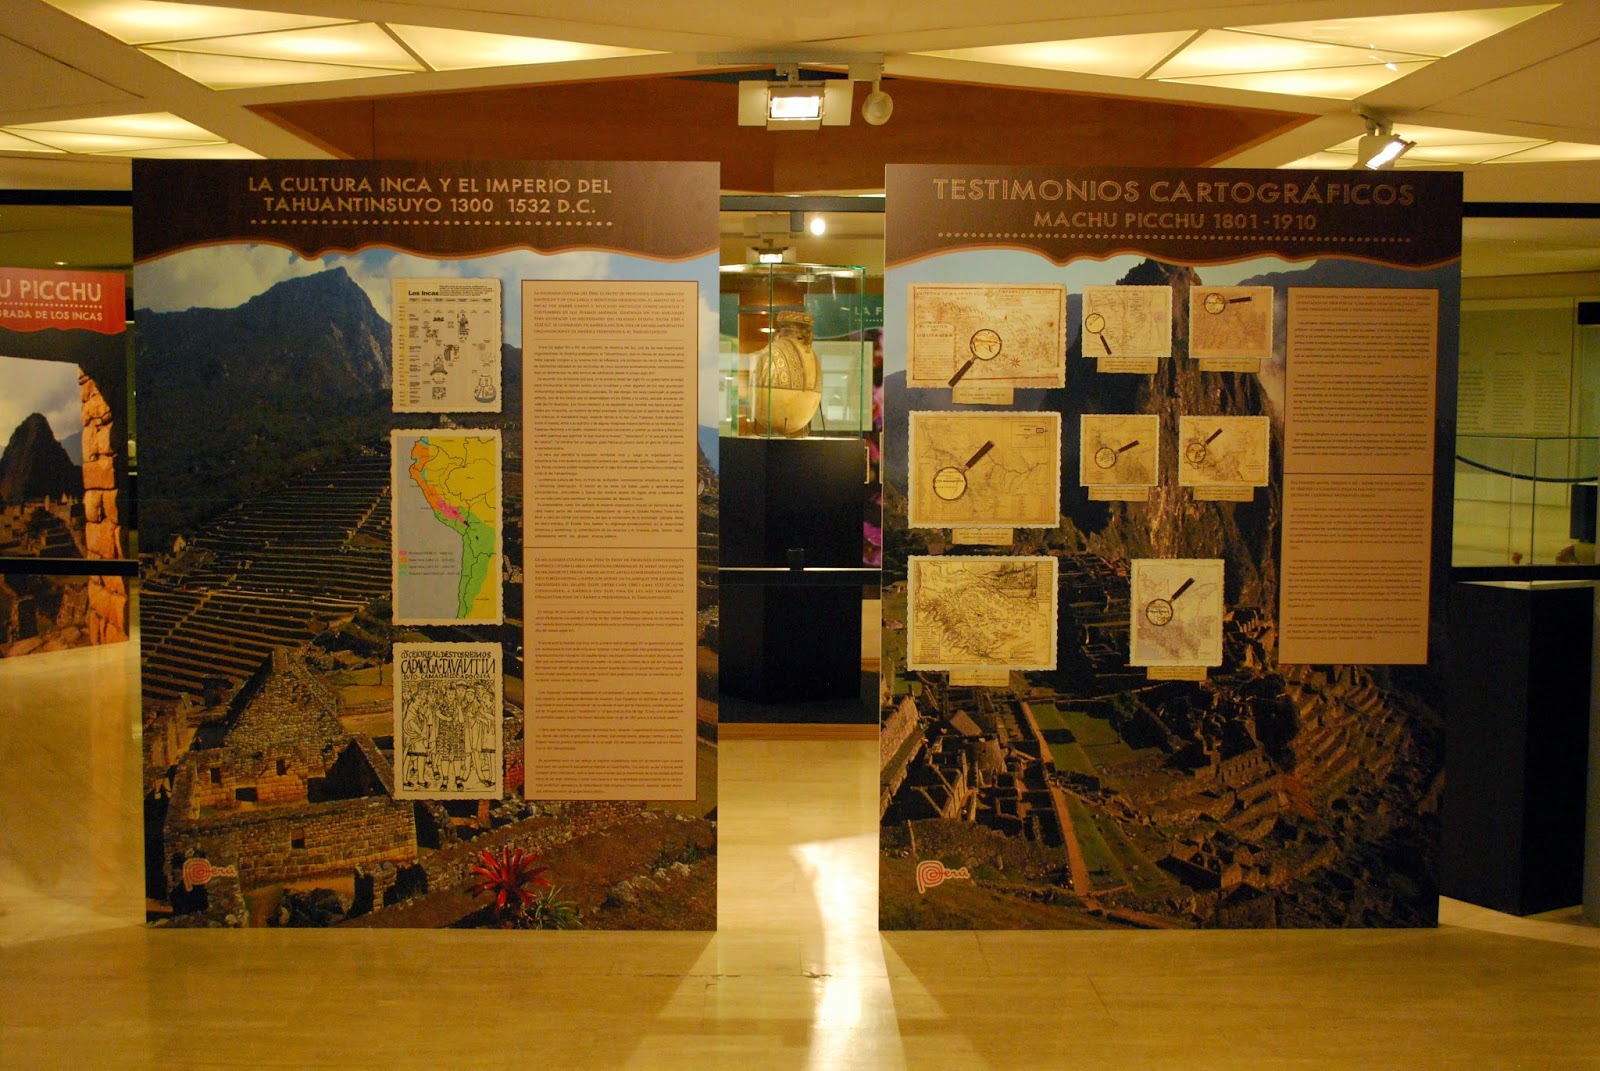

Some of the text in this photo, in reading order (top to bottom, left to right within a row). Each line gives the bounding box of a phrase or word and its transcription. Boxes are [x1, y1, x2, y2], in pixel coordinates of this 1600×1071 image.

[249, 177, 612, 194] LA CULTURA INCA Y EL IMPERIO DEL
[933, 176, 1416, 206] TESTIMONIOS CARTOGRÁFICOS
[263, 197, 597, 214] TAHUANTINSUYO 1300 1532 D.C.
[1033, 211, 1118, 229] MACHU
[1125, 212, 1205, 229] PICCHU
[20, 280, 102, 302] PICCHU
[0, 309, 103, 321] RADA DE LOS INCAS
